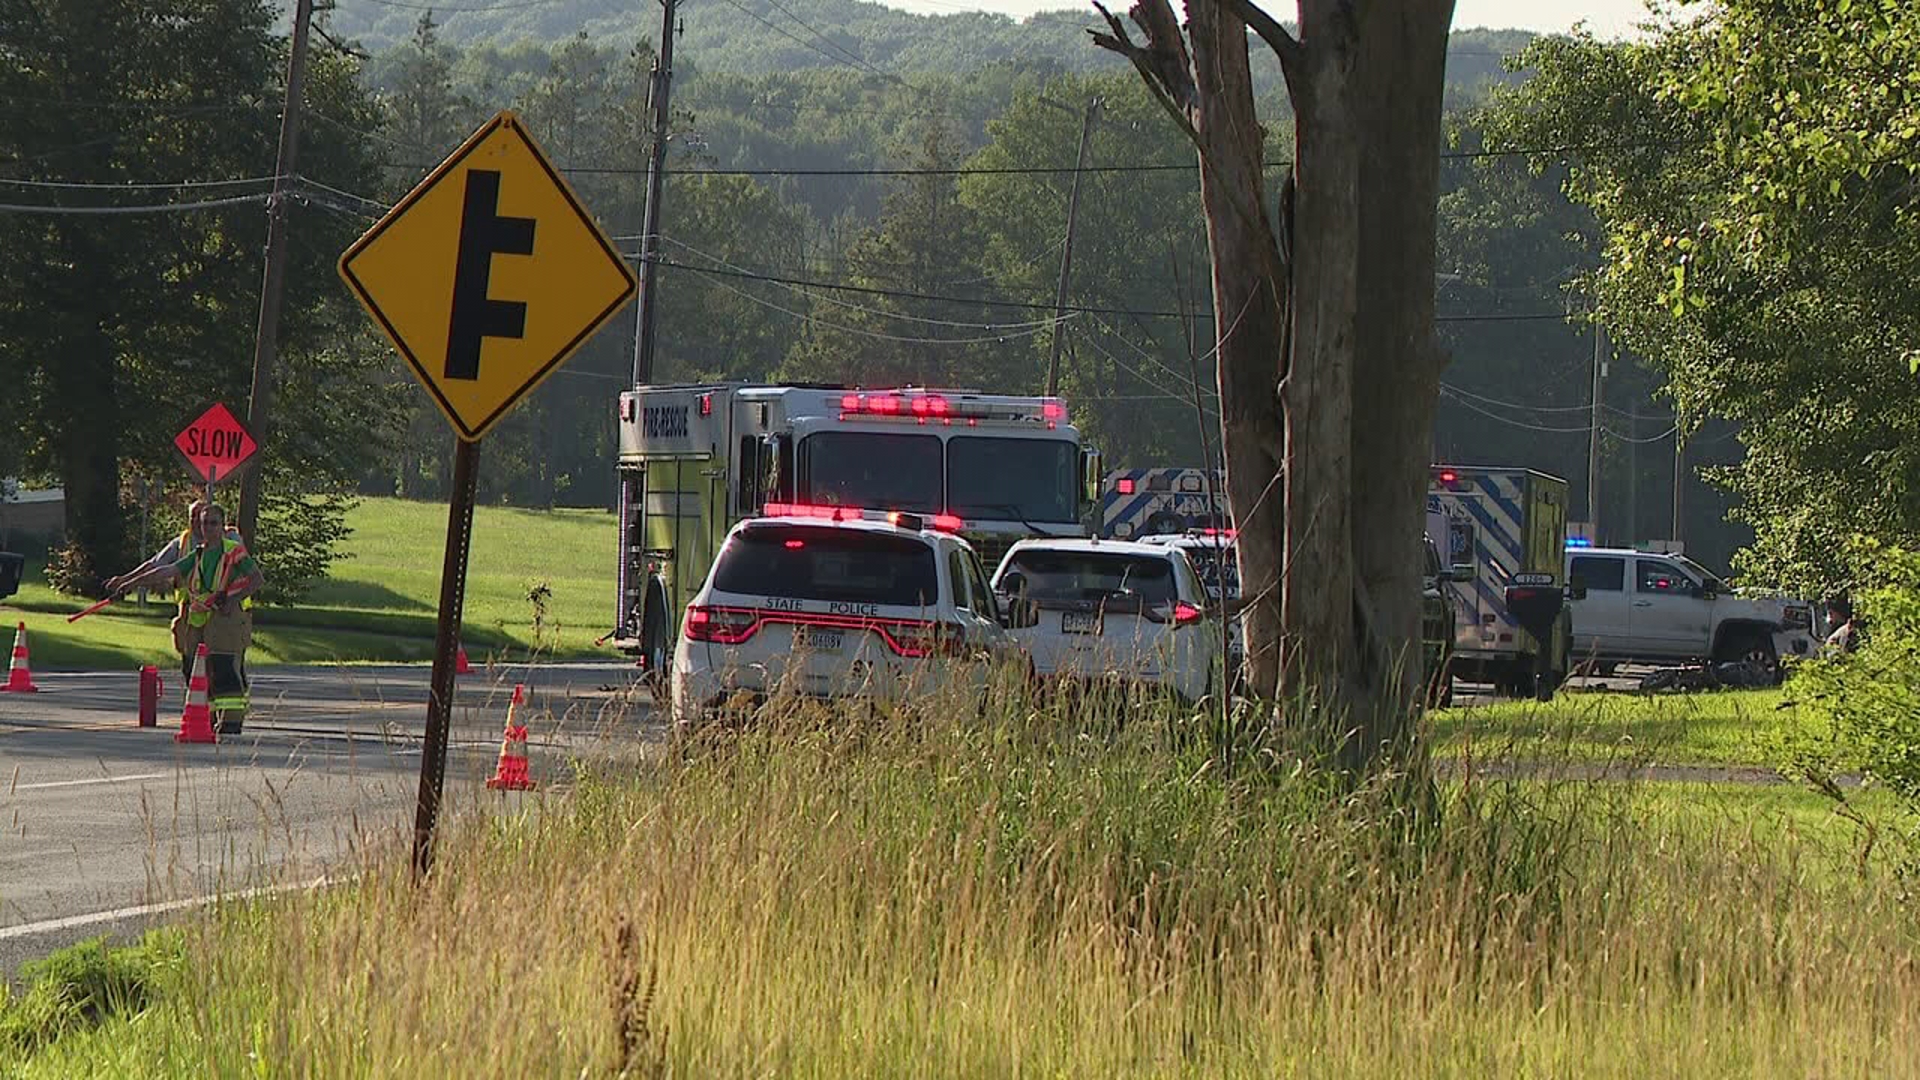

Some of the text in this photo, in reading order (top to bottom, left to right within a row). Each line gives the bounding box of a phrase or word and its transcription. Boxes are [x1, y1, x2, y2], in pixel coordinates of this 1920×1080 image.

[642, 405, 689, 439] FIRE-RESCUE
[186, 427, 244, 459] SLOW
[765, 598, 879, 616] STATE POLICE
